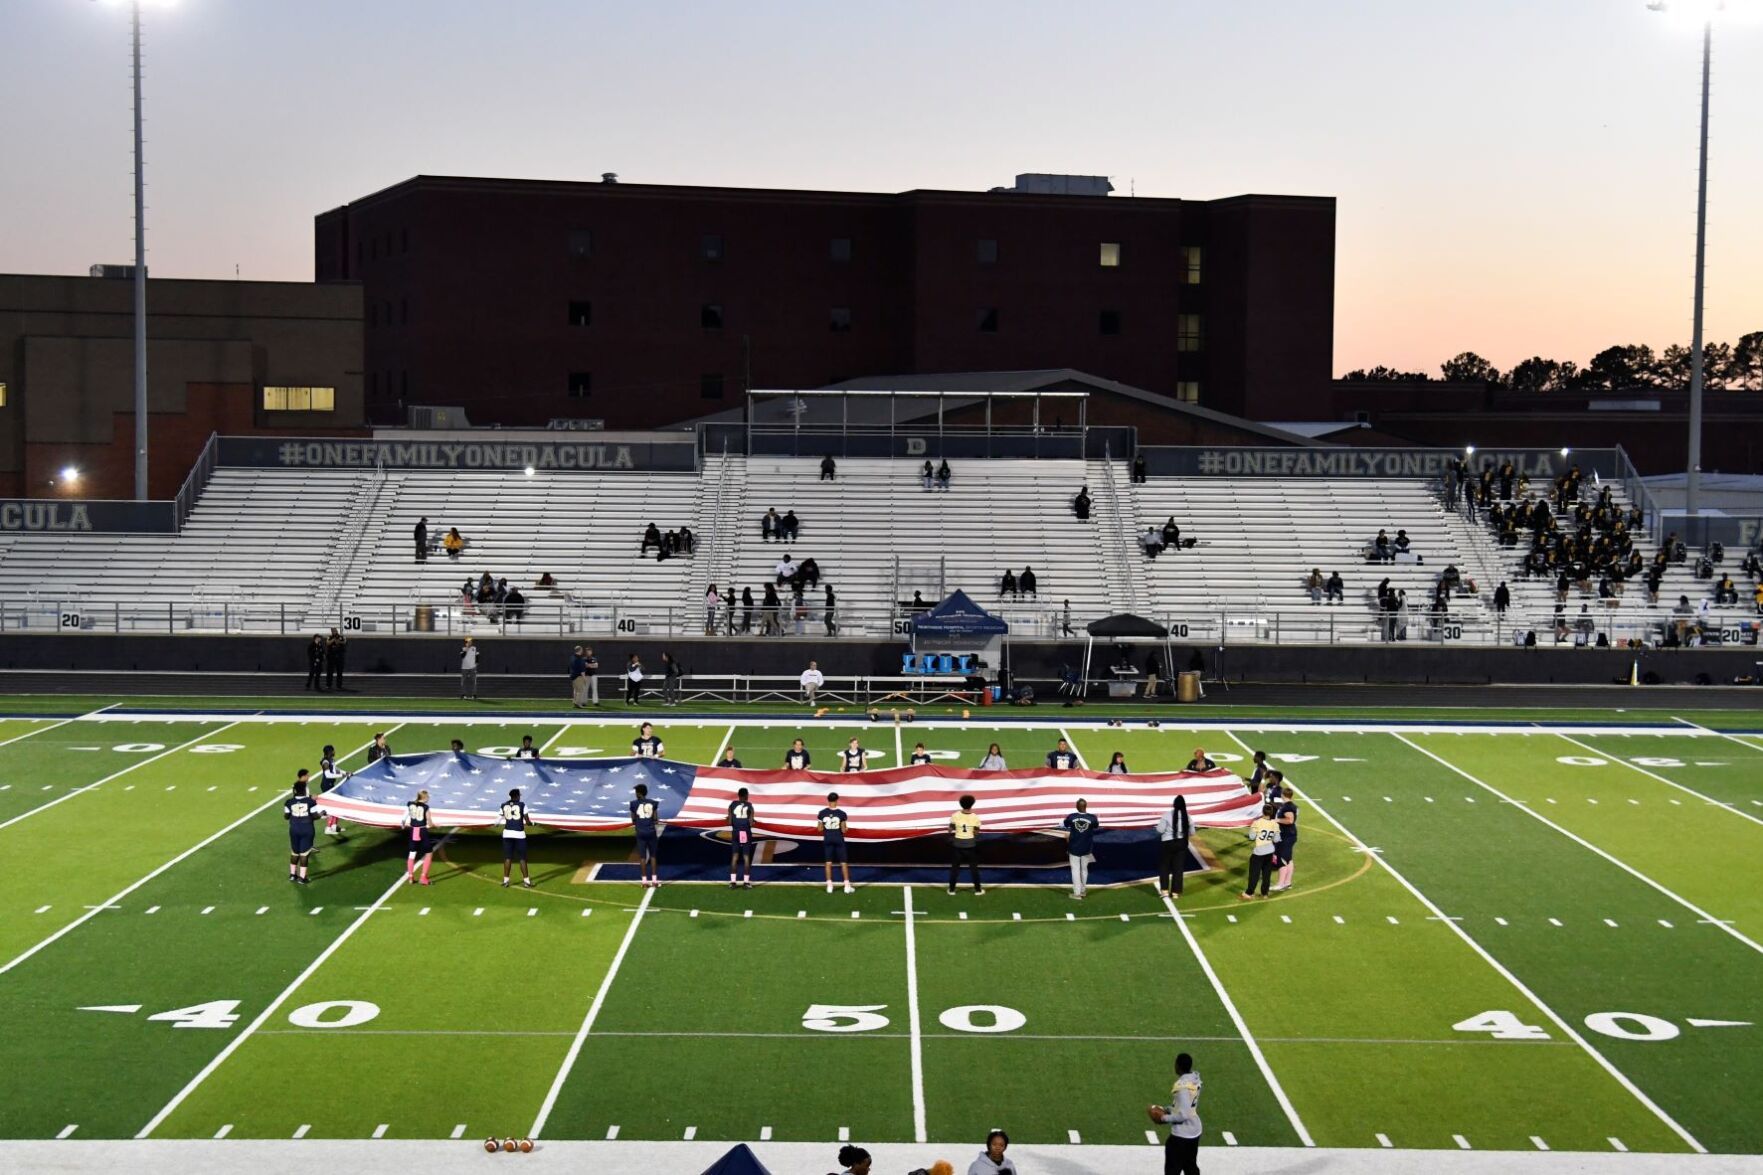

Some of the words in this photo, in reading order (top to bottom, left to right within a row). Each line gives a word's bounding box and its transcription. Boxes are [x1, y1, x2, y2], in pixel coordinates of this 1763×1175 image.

[907, 437, 927, 455] D
[278, 442, 634, 469] #ONEFAMILYONEDACULA
[62, 613, 80, 628] 20
[343, 616, 361, 631] 30
[617, 619, 636, 633] 40
[894, 621, 911, 634] 50
[1171, 624, 1189, 638] 40
[1443, 626, 1461, 640] 30
[1722, 629, 1740, 643] 20
[962, 824, 968, 832] 1
[1259, 829, 1275, 841] 36
